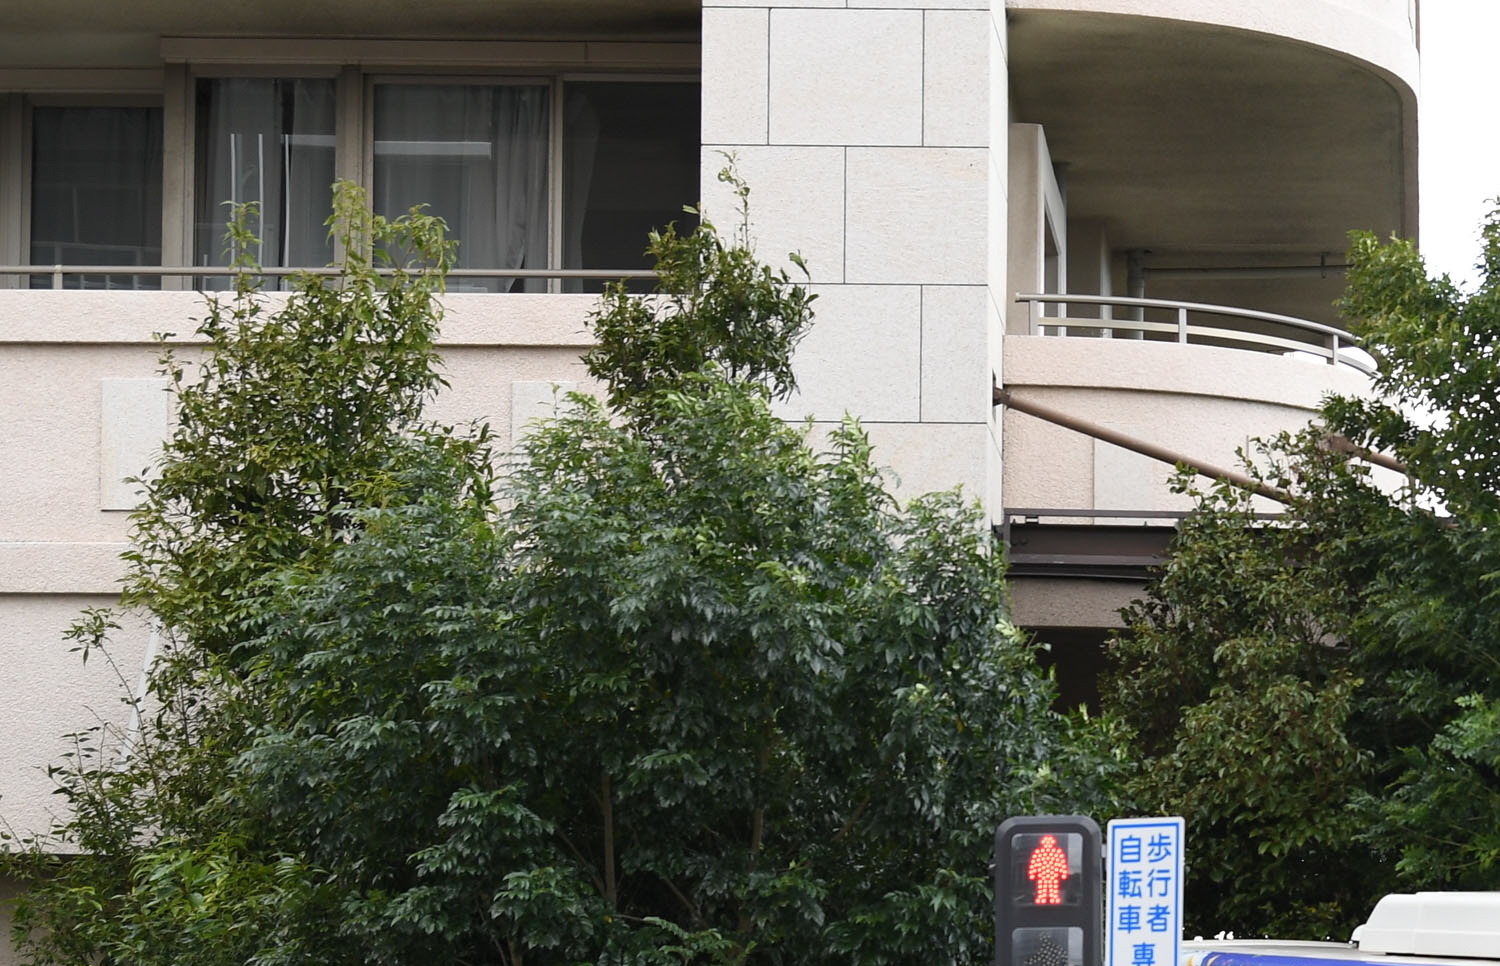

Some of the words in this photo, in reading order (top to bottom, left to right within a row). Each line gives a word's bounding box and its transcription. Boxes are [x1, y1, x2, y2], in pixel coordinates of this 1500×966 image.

[1117, 834, 1143, 934] 自転車
[1147, 833, 1172, 933] 歩行者
